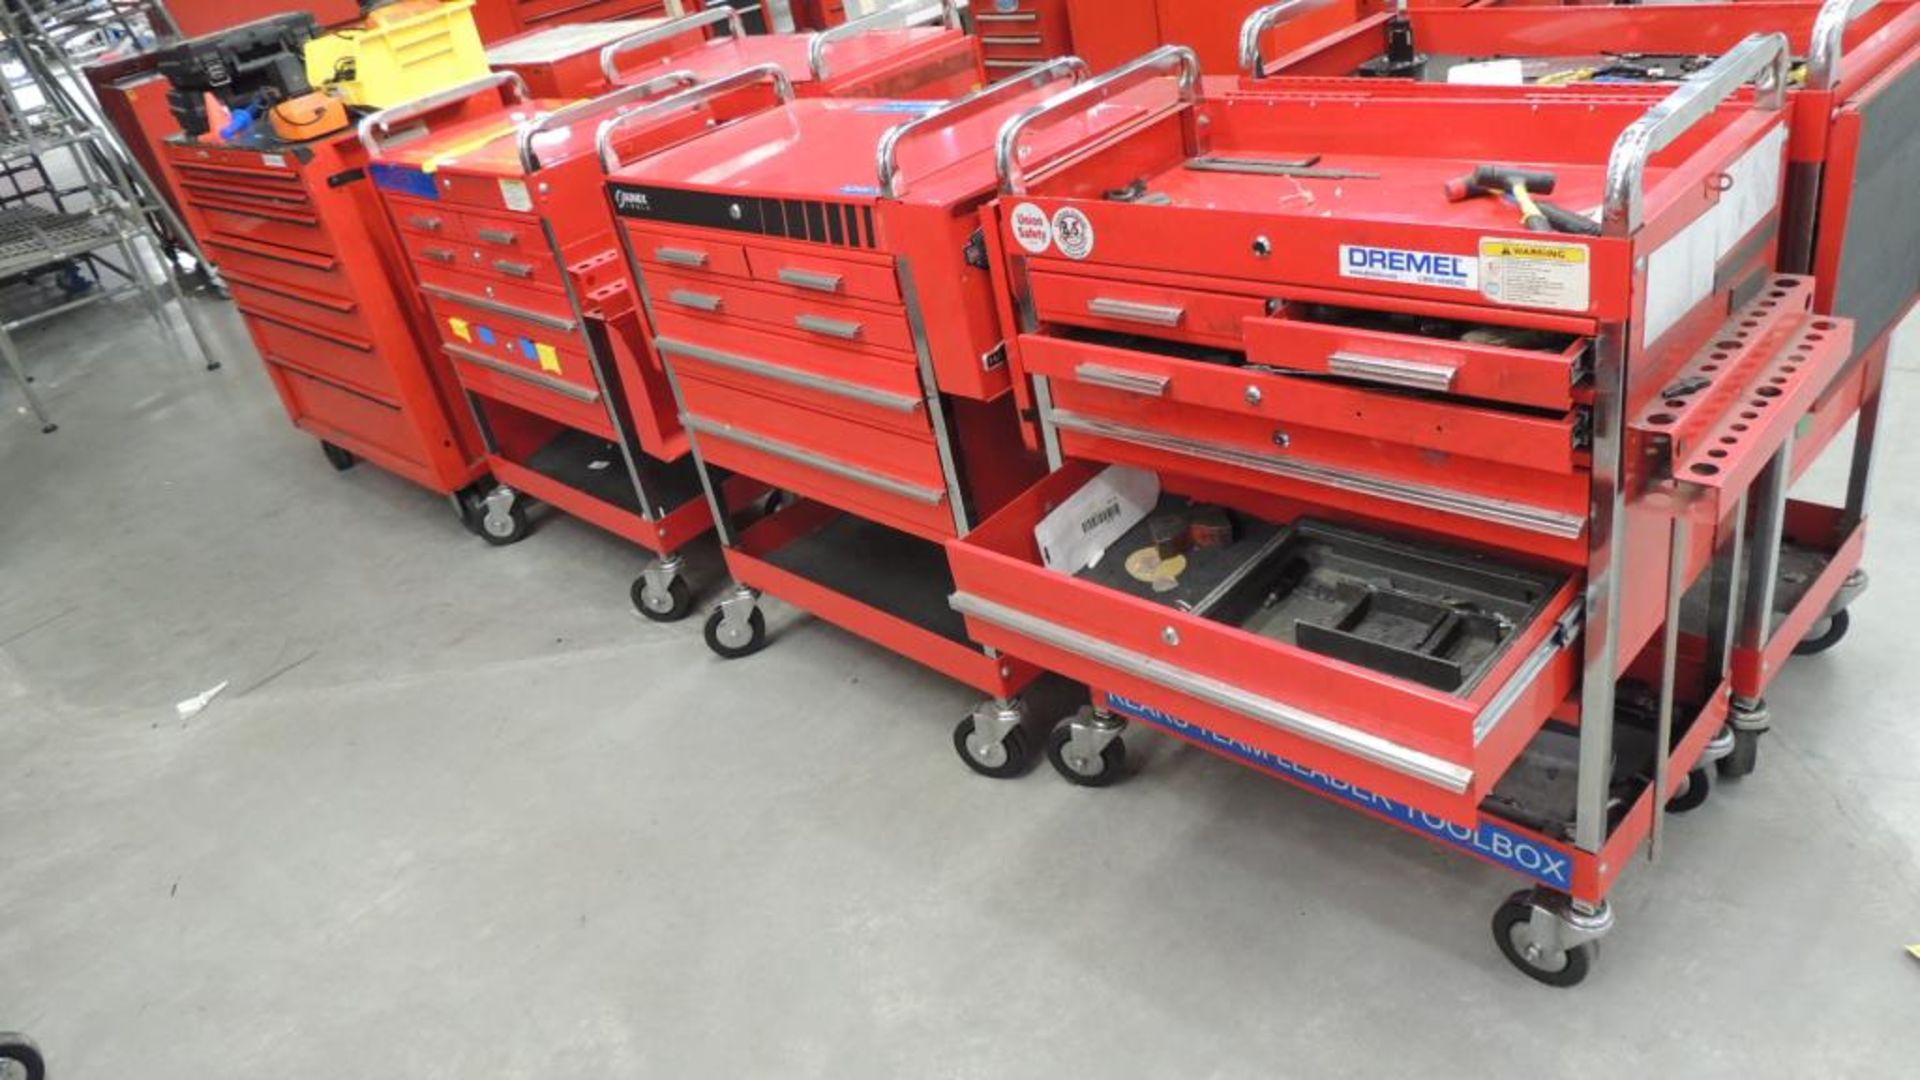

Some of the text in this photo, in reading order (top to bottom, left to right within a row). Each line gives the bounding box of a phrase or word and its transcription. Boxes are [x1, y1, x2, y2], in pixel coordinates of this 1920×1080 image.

[1017, 212, 1043, 227] Union
[1017, 226, 1047, 244] Safety
[1512, 246, 1567, 259] WARNING
[1348, 247, 1468, 278] DREMEL
